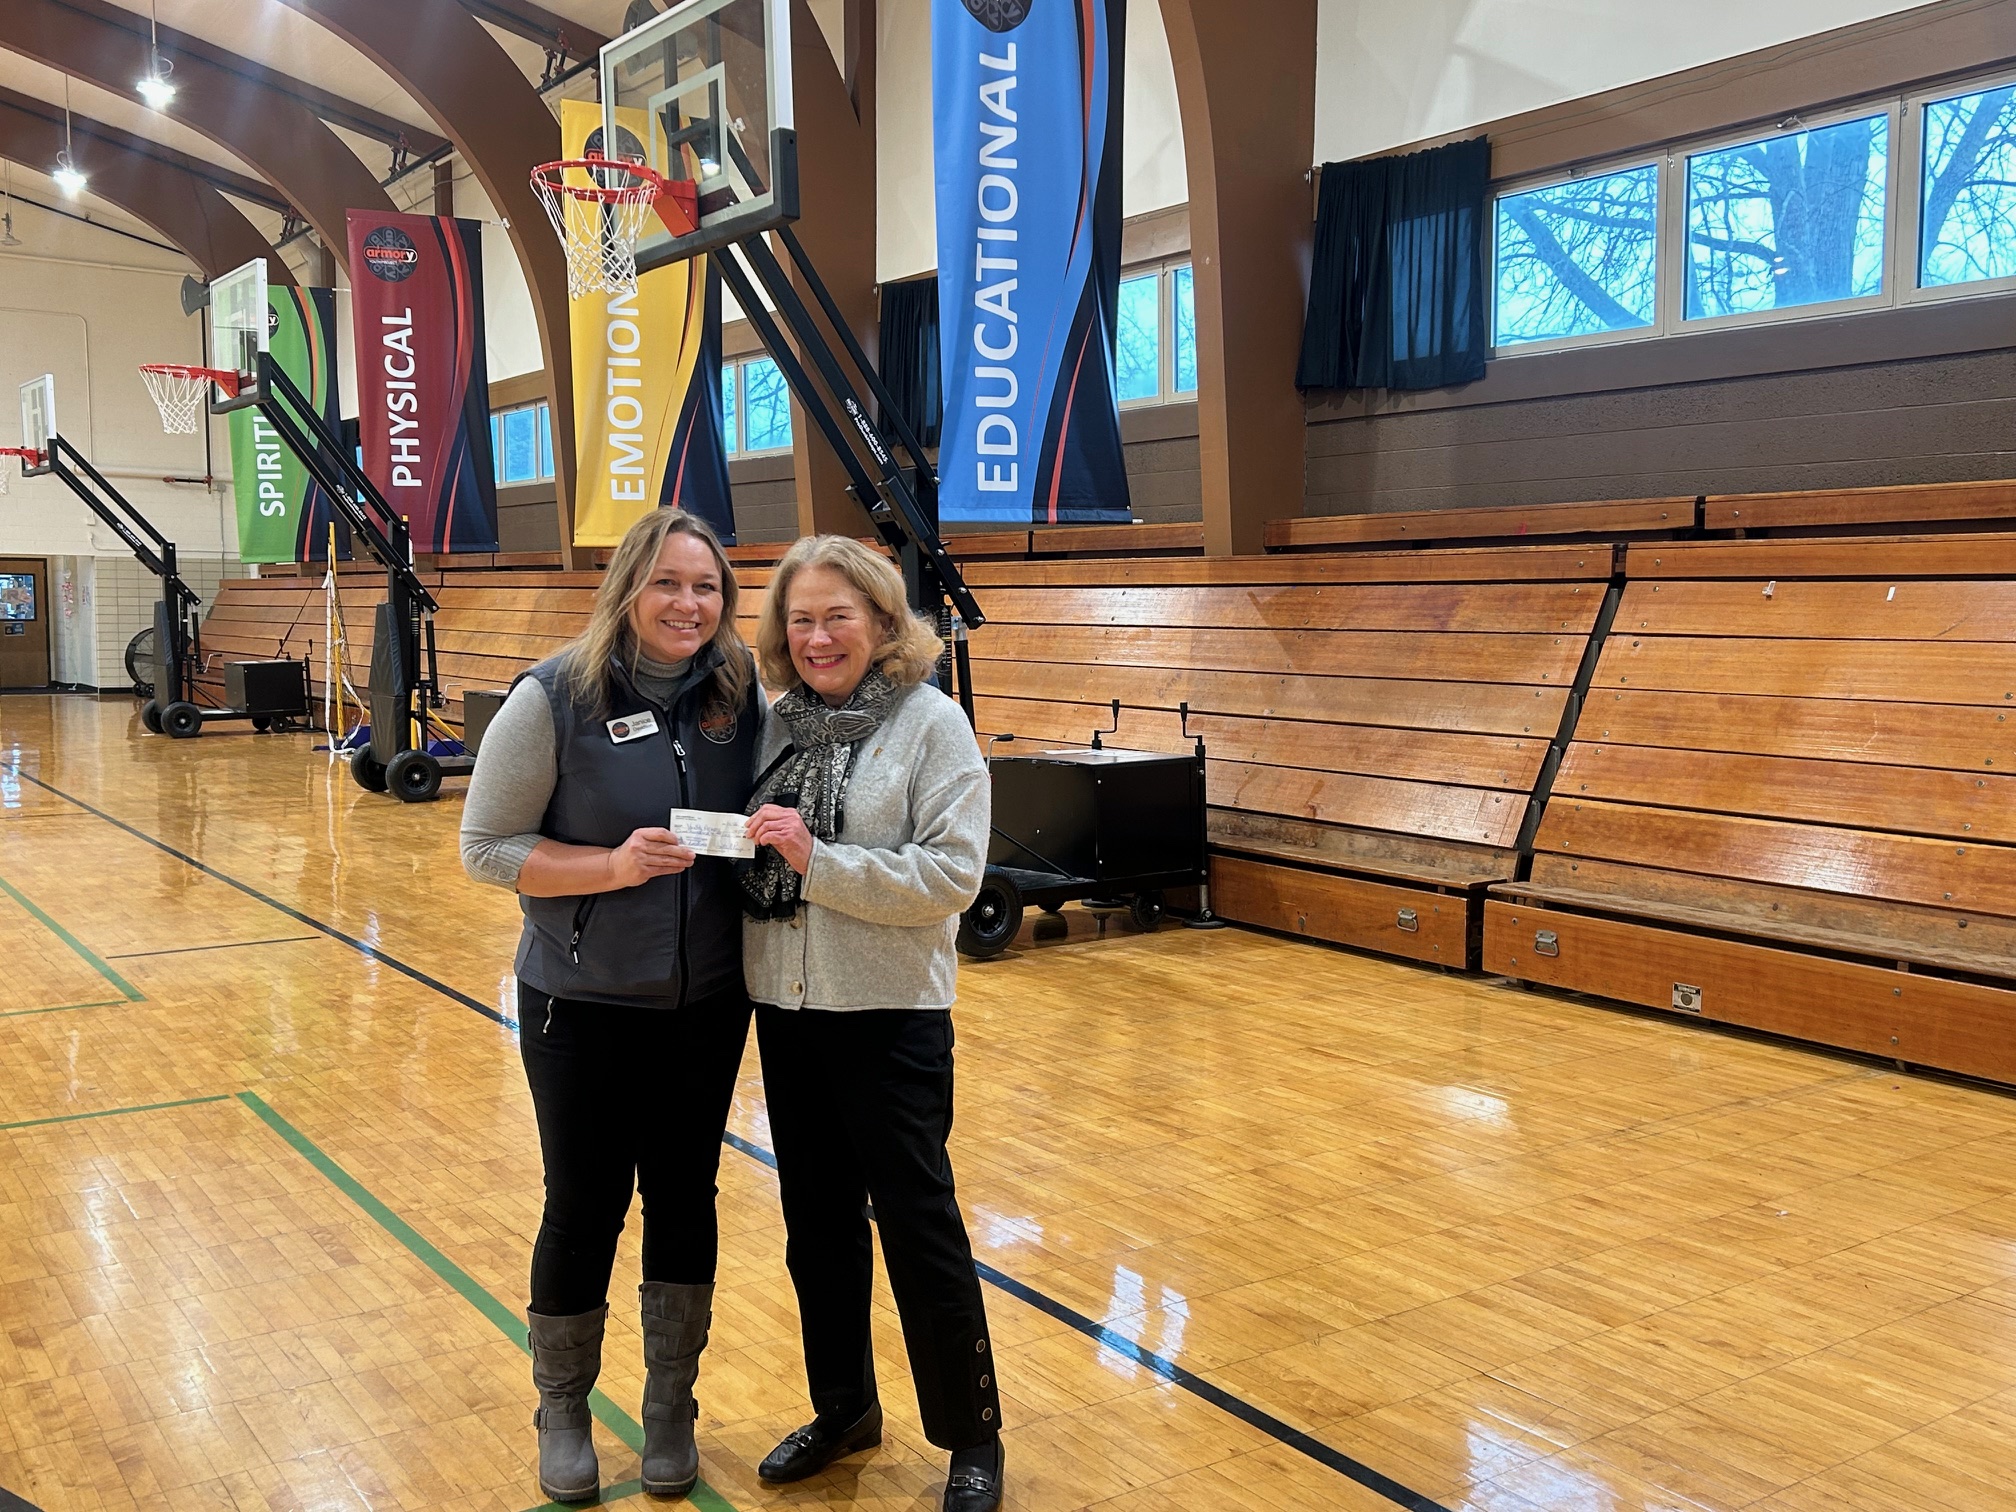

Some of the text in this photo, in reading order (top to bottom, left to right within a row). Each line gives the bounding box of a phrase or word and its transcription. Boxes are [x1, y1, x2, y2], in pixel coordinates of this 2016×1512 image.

[366, 248, 415, 262] armory
[973, 42, 1019, 492] EDUCATIONAL
[252, 416, 286, 517] SPIRIT
[381, 307, 423, 487] PHYSICAL
[606, 283, 646, 501] EMOTION
